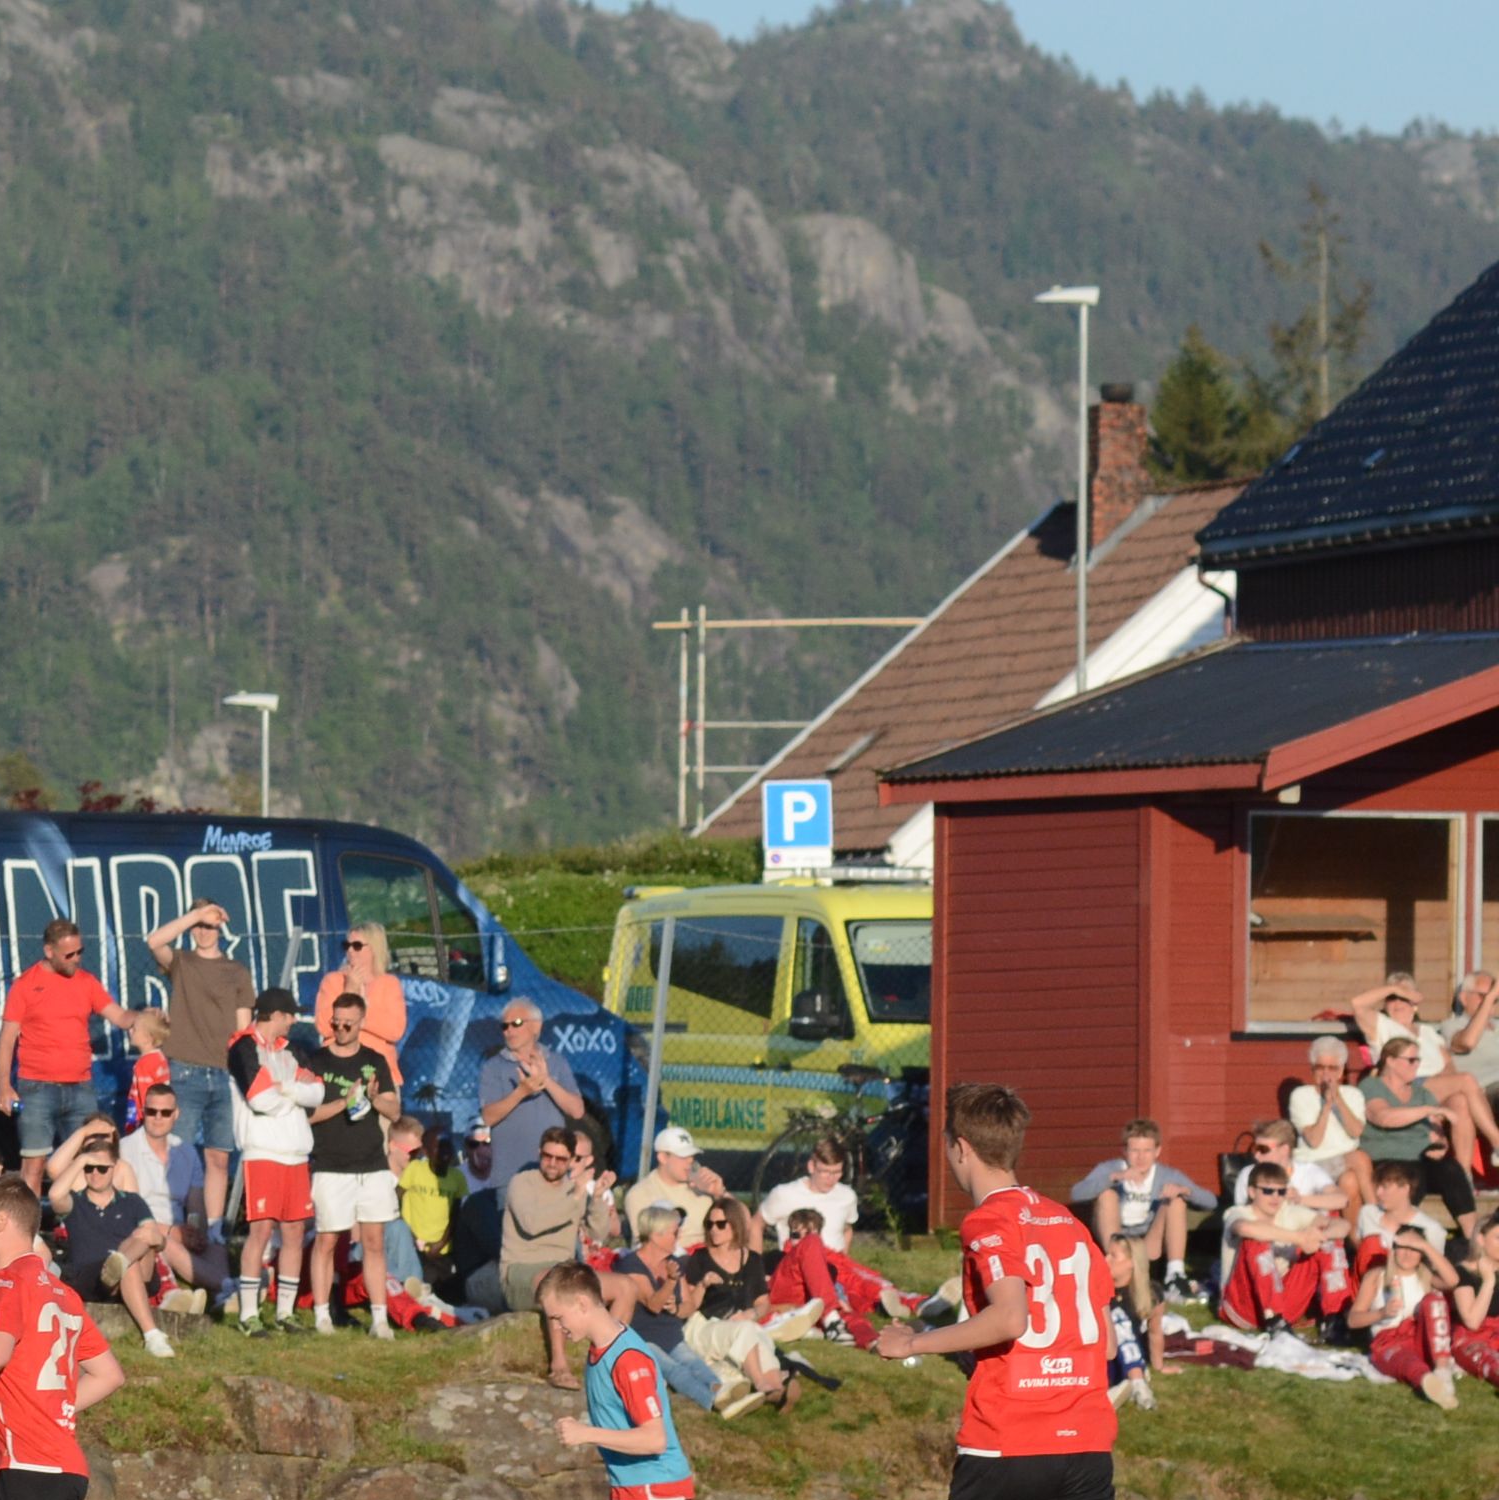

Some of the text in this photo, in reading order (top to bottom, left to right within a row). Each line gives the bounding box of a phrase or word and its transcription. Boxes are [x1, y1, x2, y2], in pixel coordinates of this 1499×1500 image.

[782, 791, 817, 842] P
[669, 1097, 765, 1131] AMBULANSE
[1018, 1241, 1099, 1349] 31
[36, 1302, 83, 1391] 27
